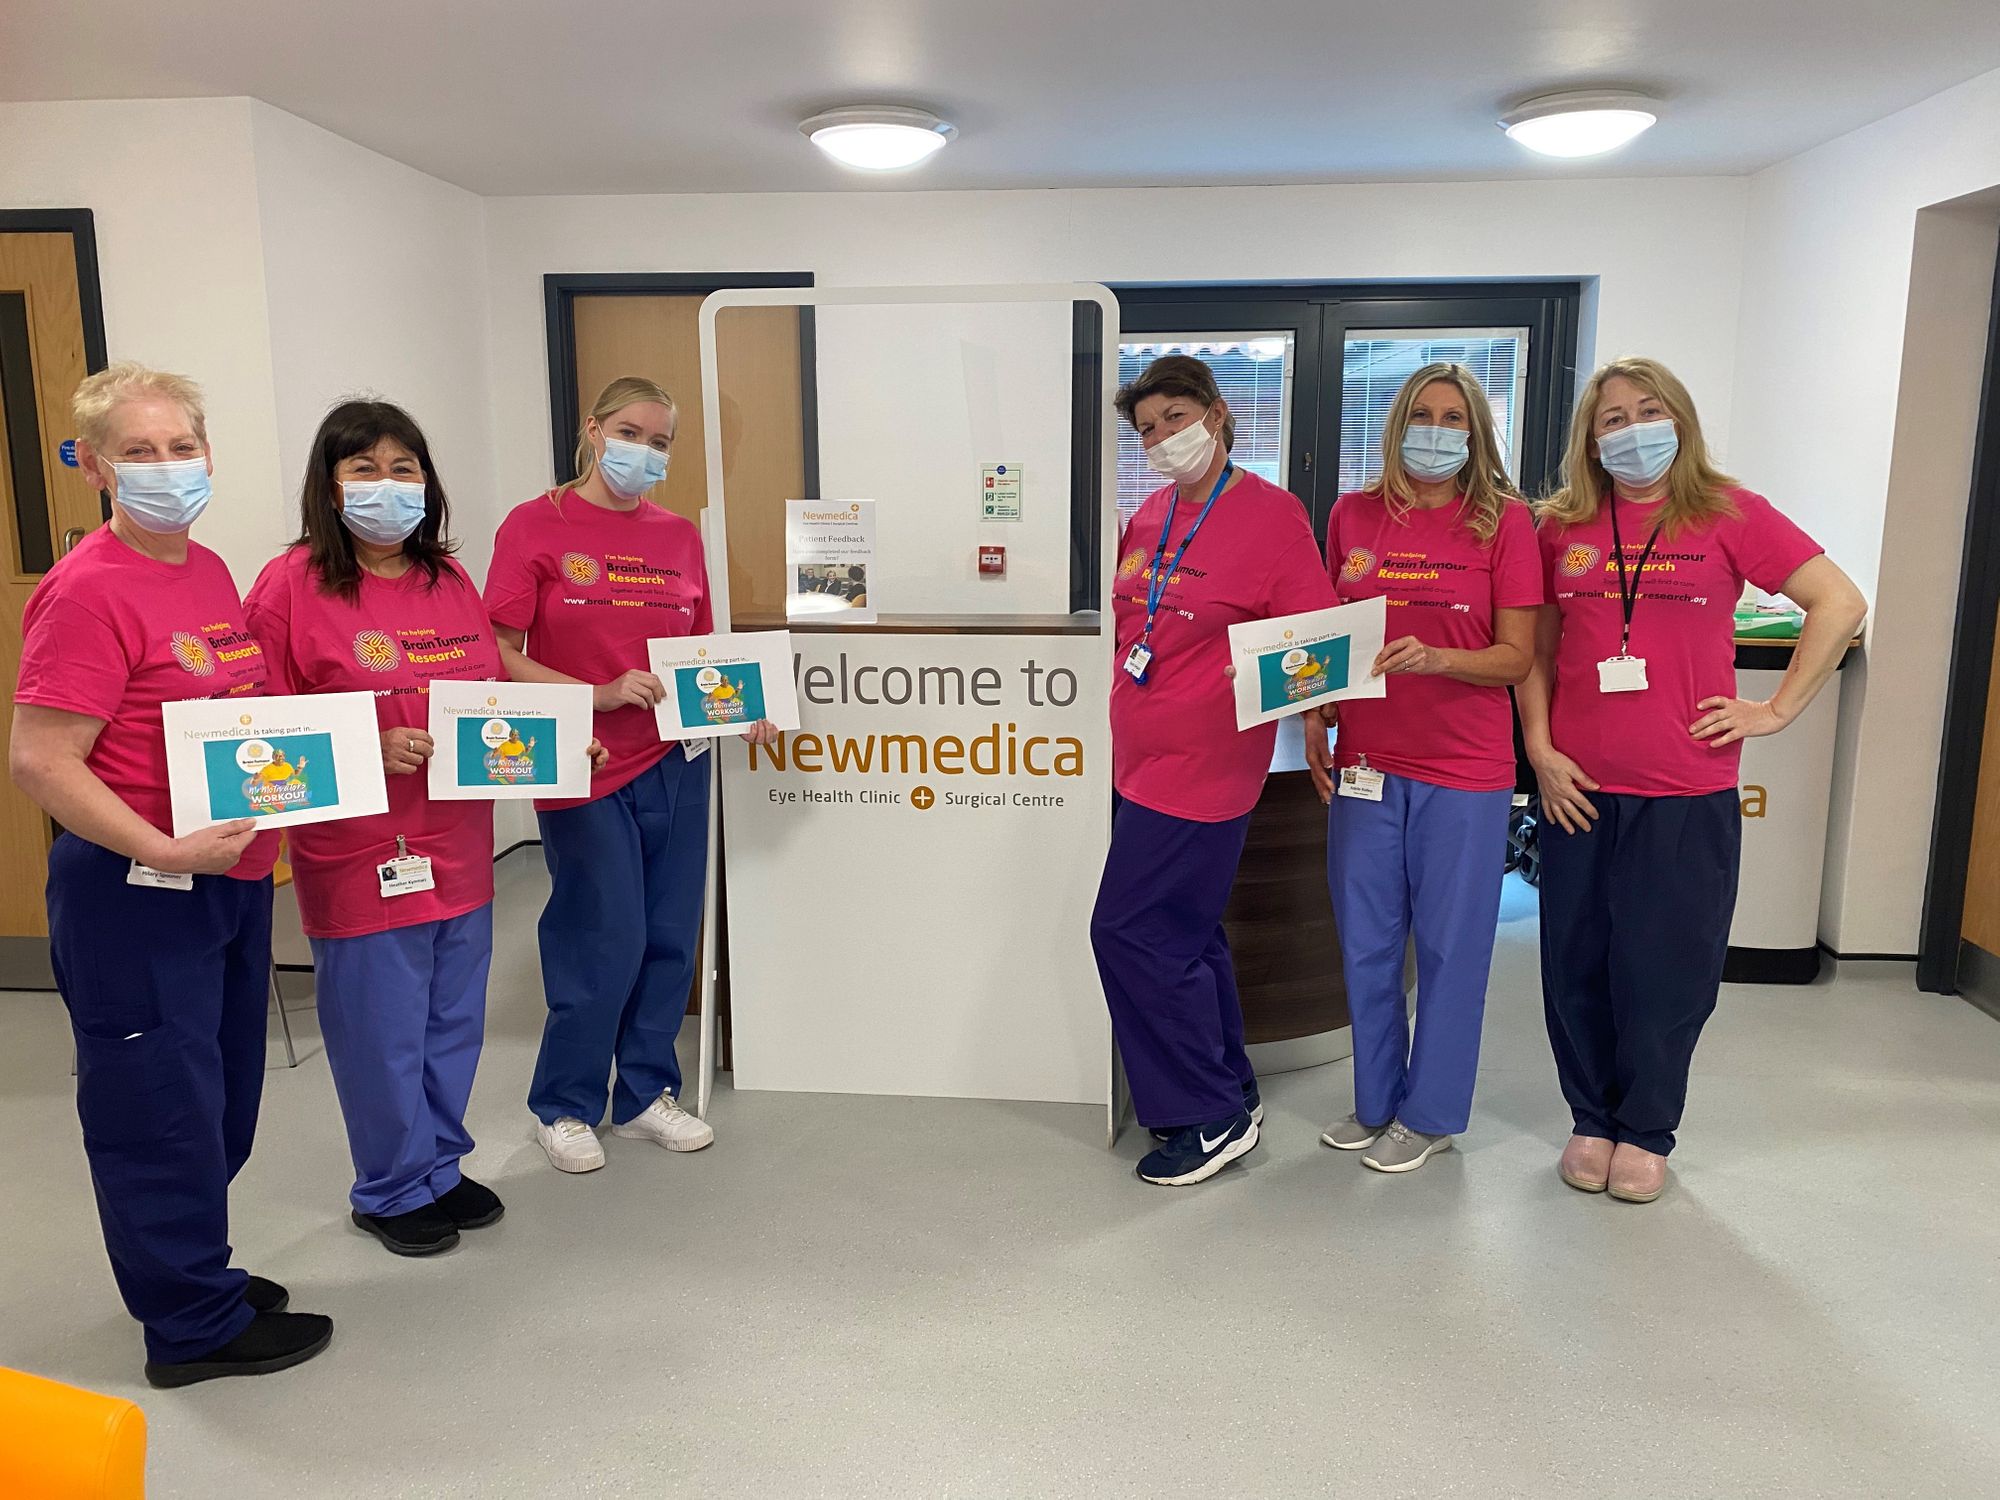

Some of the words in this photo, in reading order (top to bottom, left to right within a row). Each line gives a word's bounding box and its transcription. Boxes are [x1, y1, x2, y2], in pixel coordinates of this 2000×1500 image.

[802, 512, 858, 520] Newmedica
[617, 554, 644, 562] helping
[1400, 551, 1427, 559] helping
[1650, 552, 1706, 562] Tumour
[606, 562, 640, 574] Brain
[640, 564, 682, 579] Tumour
[1382, 560, 1418, 570] Brain
[1419, 560, 1468, 571] Tumour
[608, 573, 665, 585] Research
[1175, 566, 1208, 579] umour
[1378, 568, 1440, 580] Research
[564, 597, 690, 616] www.braintumourresearch.org
[409, 628, 436, 637] helping
[208, 634, 236, 649] Brain
[400, 638, 435, 651] Brain
[435, 632, 480, 648] Tumour
[1242, 641, 1292, 655] Newmedica
[1300, 636, 1318, 645] taking
[1318, 633, 1330, 641] part
[406, 647, 466, 664] Research
[662, 658, 706, 668] Newmedica
[1020, 660, 1078, 707] to
[1288, 680, 1327, 696] WORKOUT
[443, 706, 495, 716] Newmedica
[707, 708, 744, 716] WORKOUT
[184, 727, 250, 740] Newmedica
[262, 728, 285, 736] taking
[749, 722, 1084, 778] Newmedica
[251, 790, 306, 804] WORKOUT
[768, 790, 796, 805] Eye
[802, 790, 854, 804] Health
[860, 790, 900, 804] Clinic
[946, 792, 1006, 808] Surgical
[1012, 793, 1064, 808] Centre
